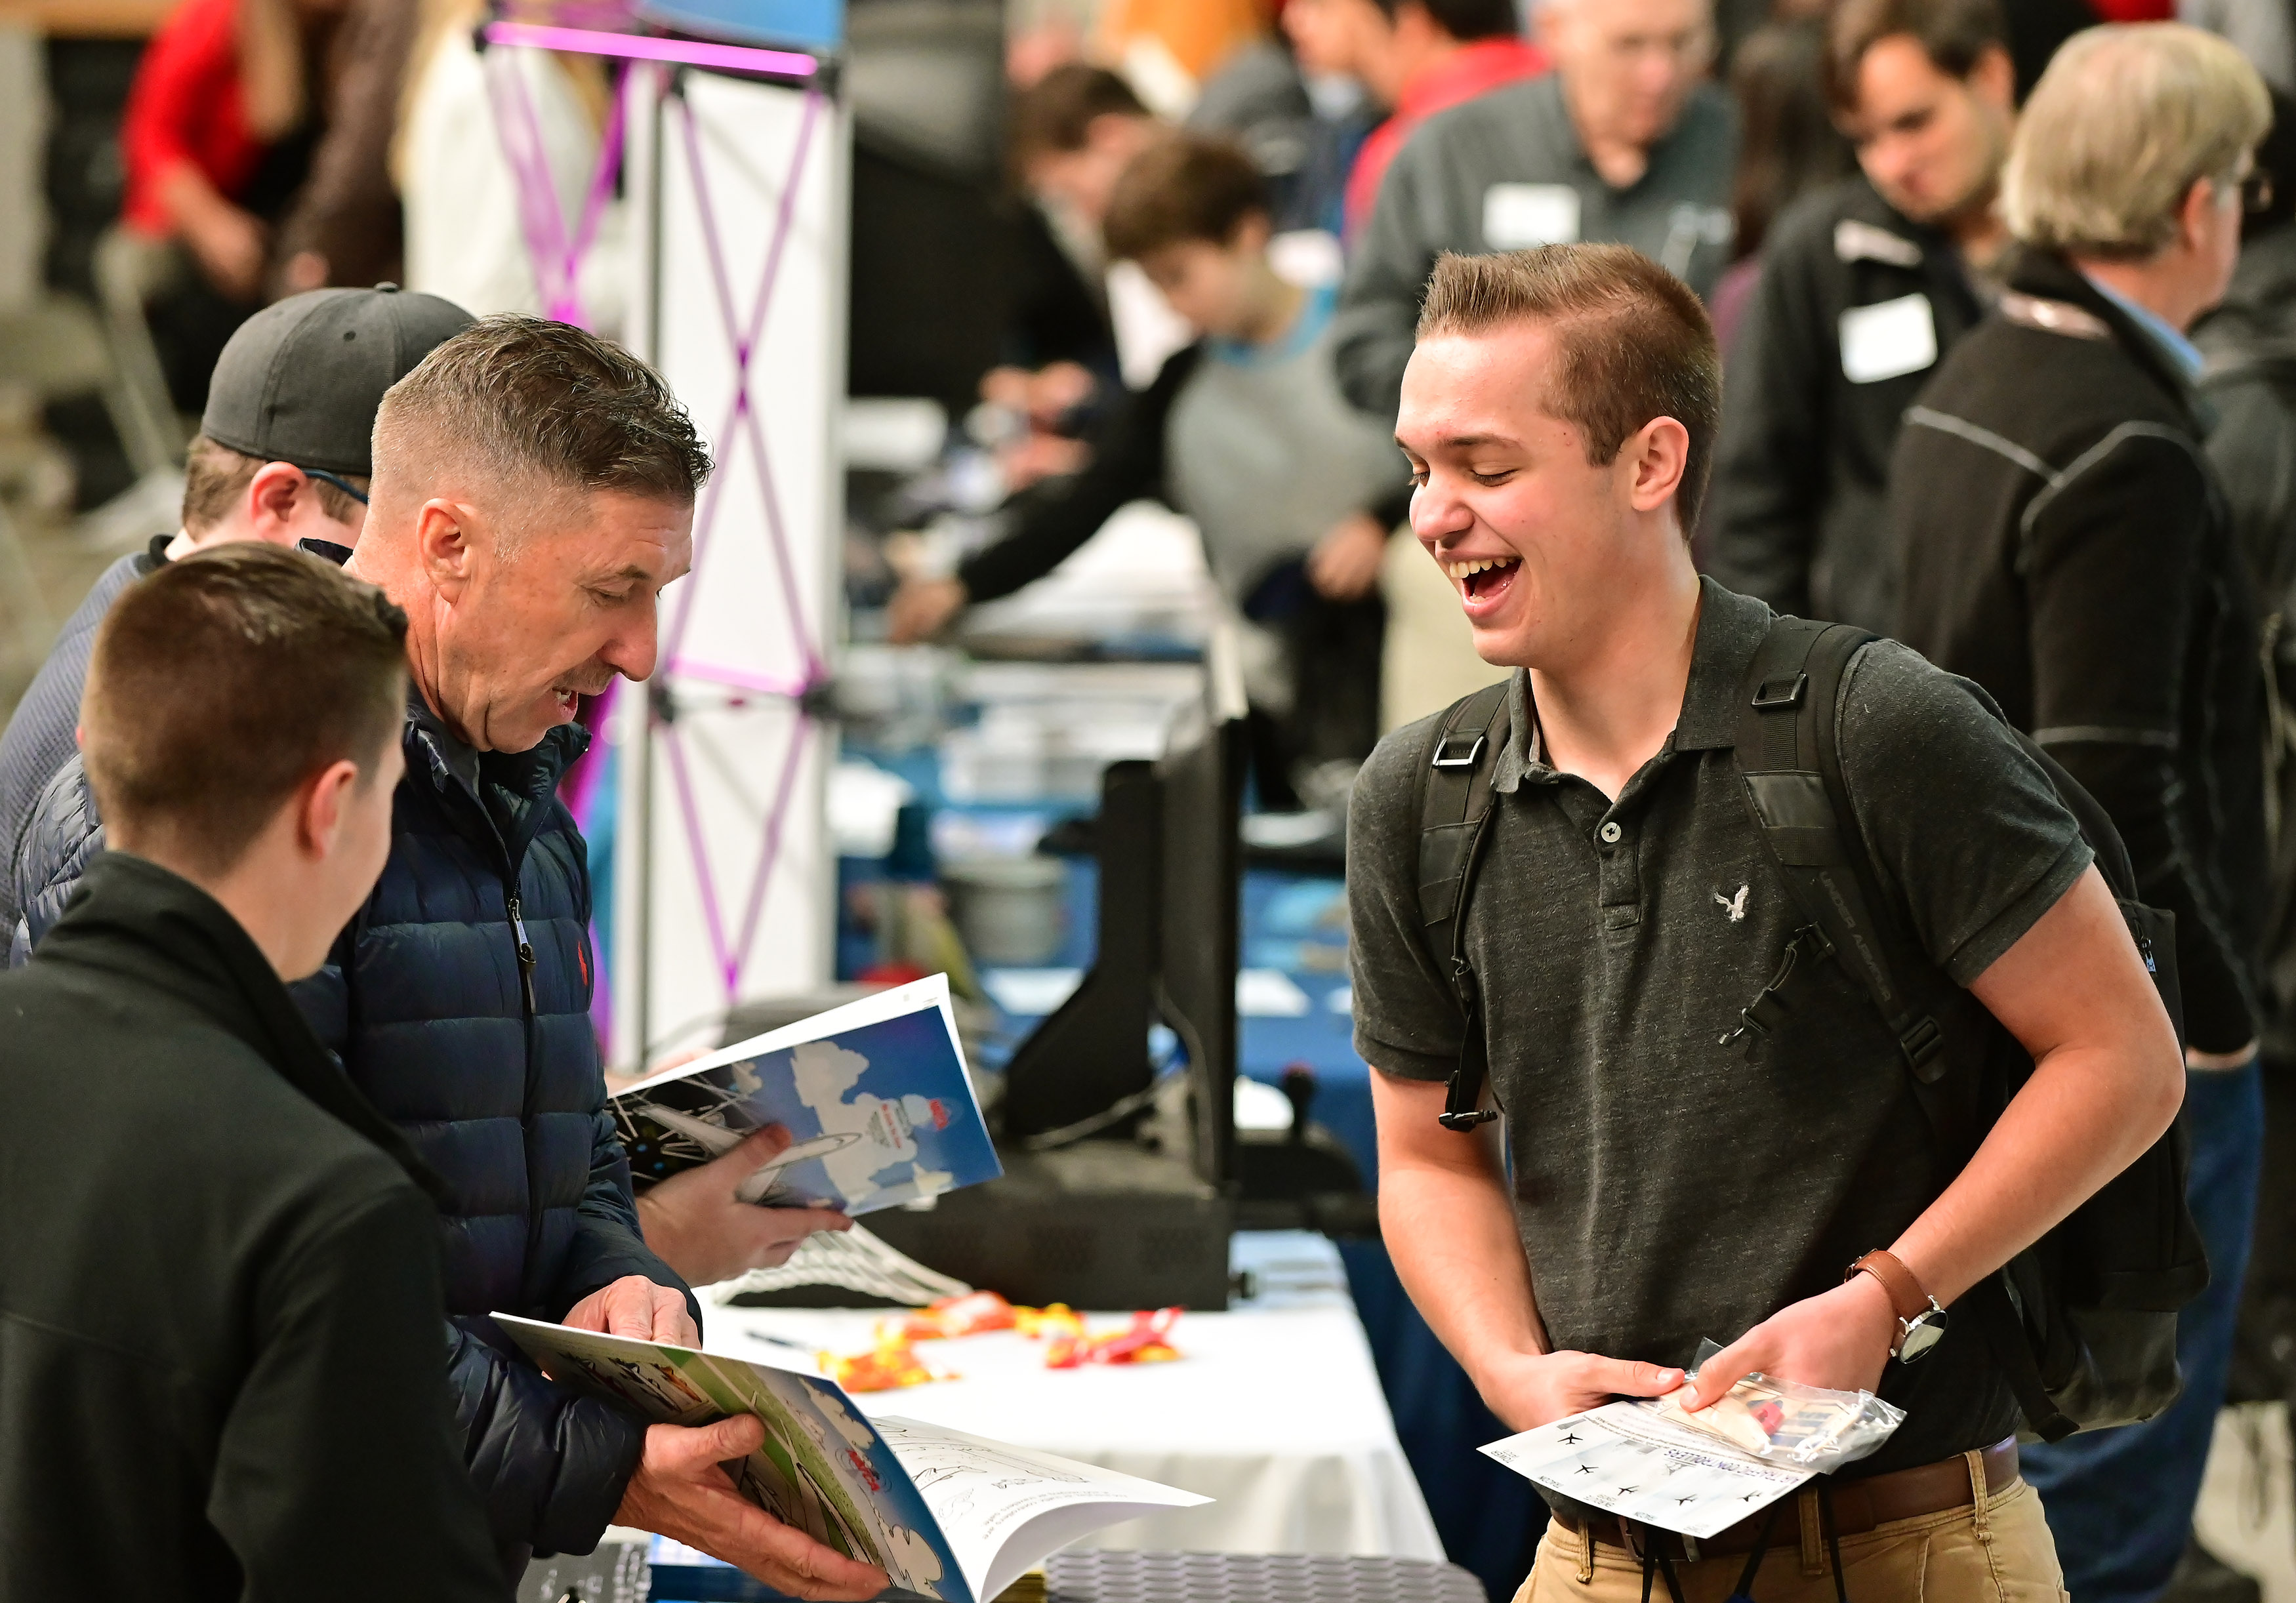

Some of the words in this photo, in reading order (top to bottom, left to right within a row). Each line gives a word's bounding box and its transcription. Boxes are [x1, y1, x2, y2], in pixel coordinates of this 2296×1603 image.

[1820, 870, 1856, 929] UNDER
[1852, 933, 1892, 1002] ARMOUR
[1490, 1450, 1514, 1463] TOWER
[1664, 1449, 1740, 1471] CONTROLLERS
[1737, 1466, 1781, 1481] TRAFFIC
